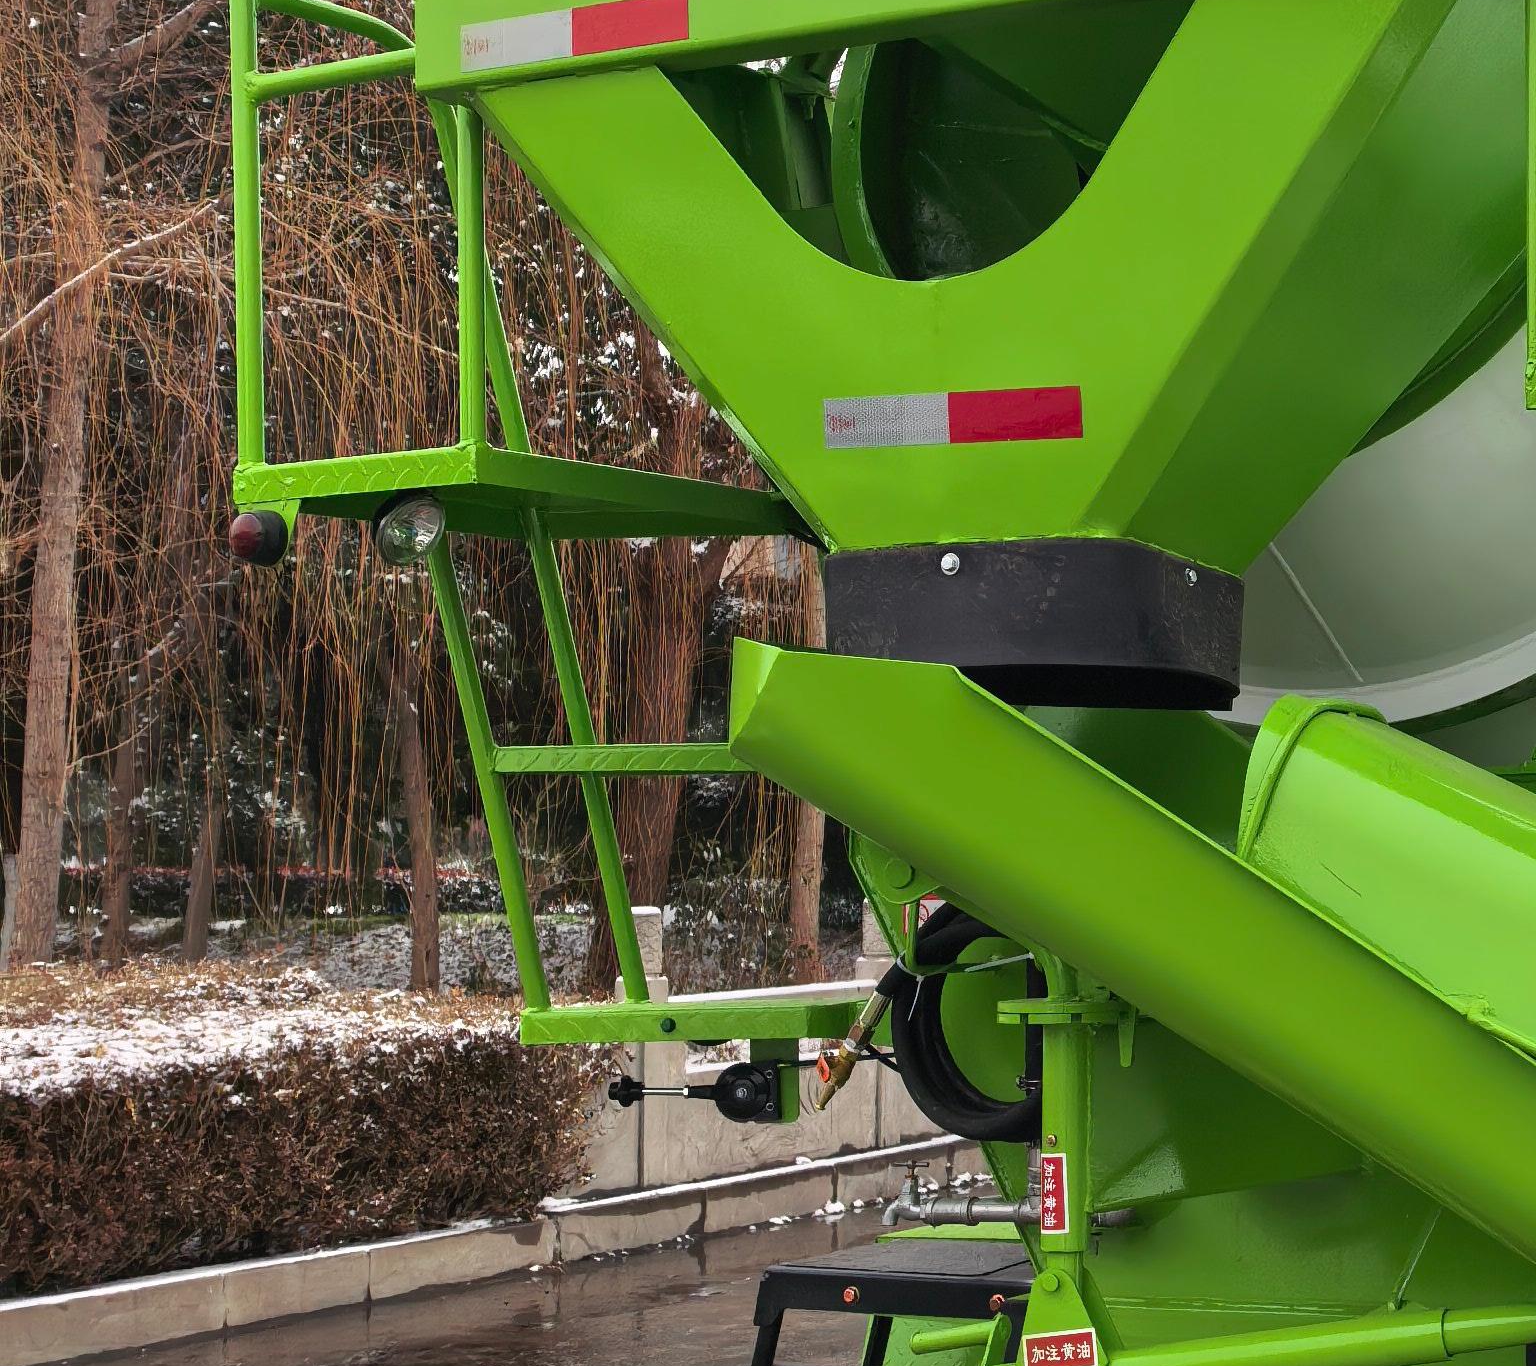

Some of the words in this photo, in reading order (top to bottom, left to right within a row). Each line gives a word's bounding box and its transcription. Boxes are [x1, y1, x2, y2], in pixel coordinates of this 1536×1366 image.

[1043, 1160, 1058, 1228] 加注黄油
[1031, 1340, 1091, 1364] 加注黄油
